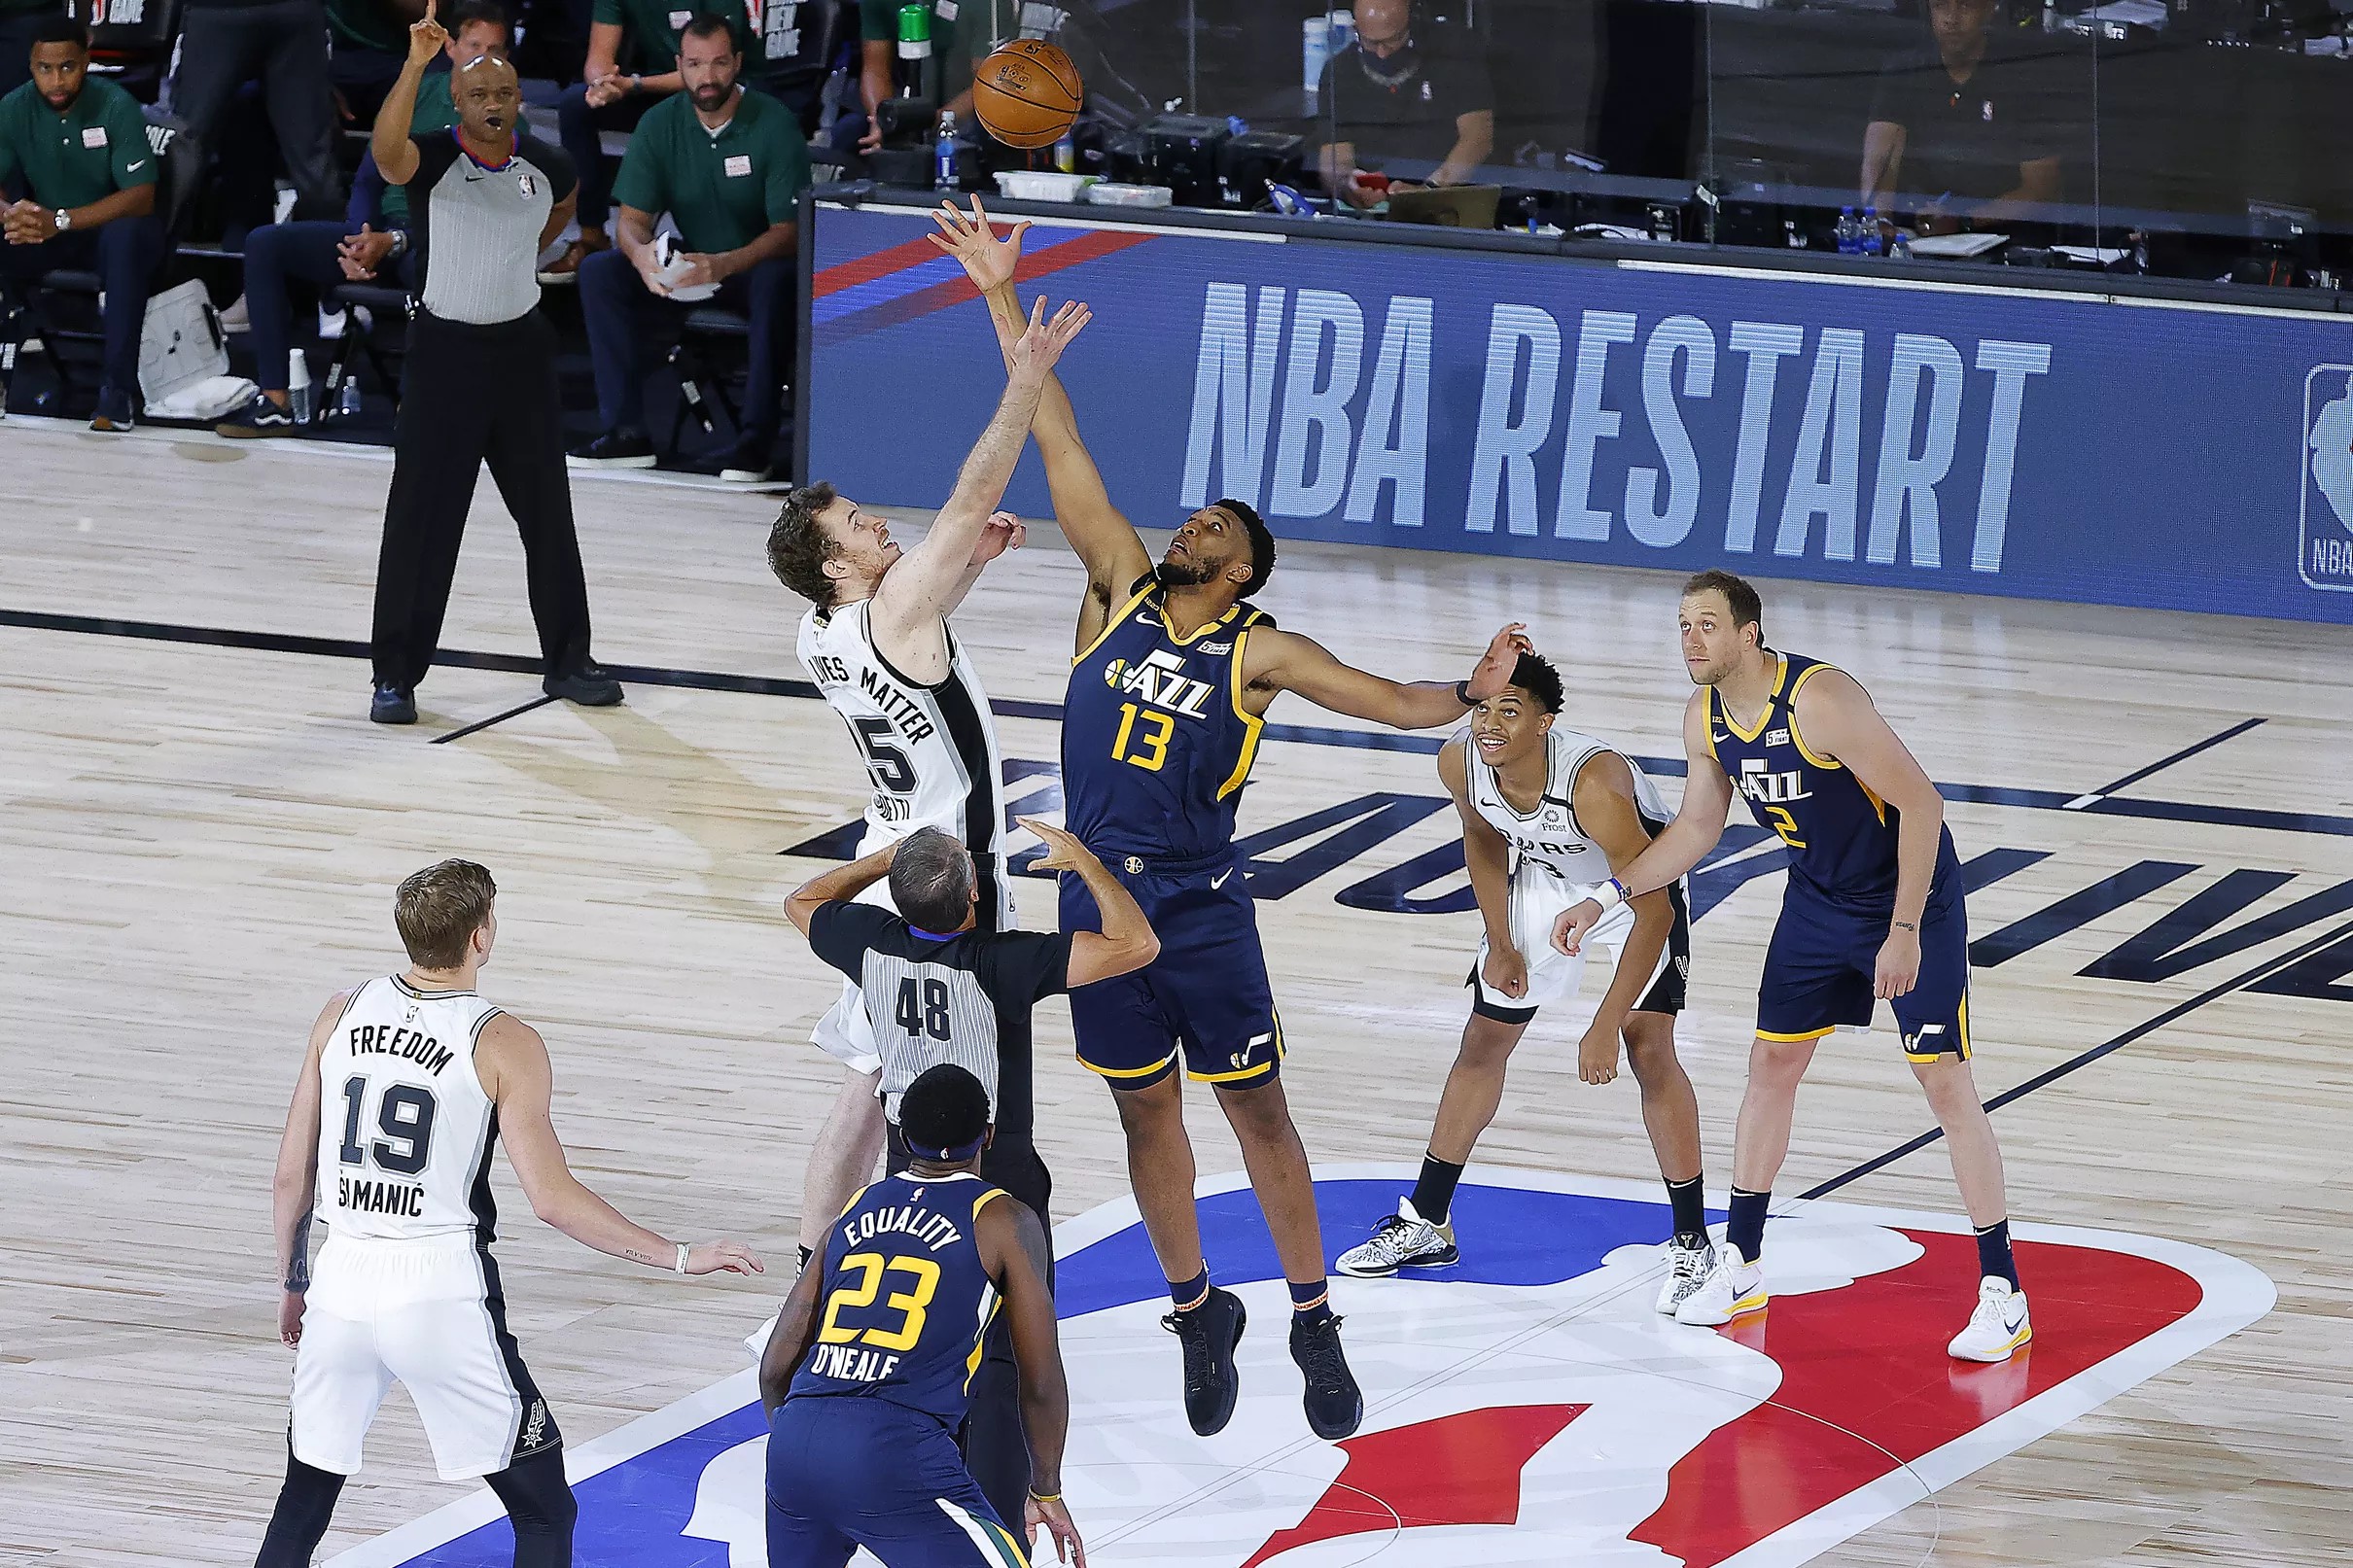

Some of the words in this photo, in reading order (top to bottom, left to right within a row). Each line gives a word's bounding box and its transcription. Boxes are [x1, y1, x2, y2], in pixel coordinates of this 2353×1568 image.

[1179, 282, 1434, 527] NBA
[1464, 302, 2054, 574] RESTART
[860, 666, 934, 746] MATTER
[1105, 648, 1215, 719] JAZZ
[839, 712, 920, 795] 5
[1110, 702, 1176, 772] 13
[1541, 822, 1568, 833] Frost
[1764, 806, 1807, 849] 2
[896, 976, 952, 1042] 48
[351, 1025, 454, 1076] FREEDOM
[339, 1073, 439, 1178] 19
[843, 1205, 963, 1252] EQUALITY
[817, 1252, 942, 1352] 23
